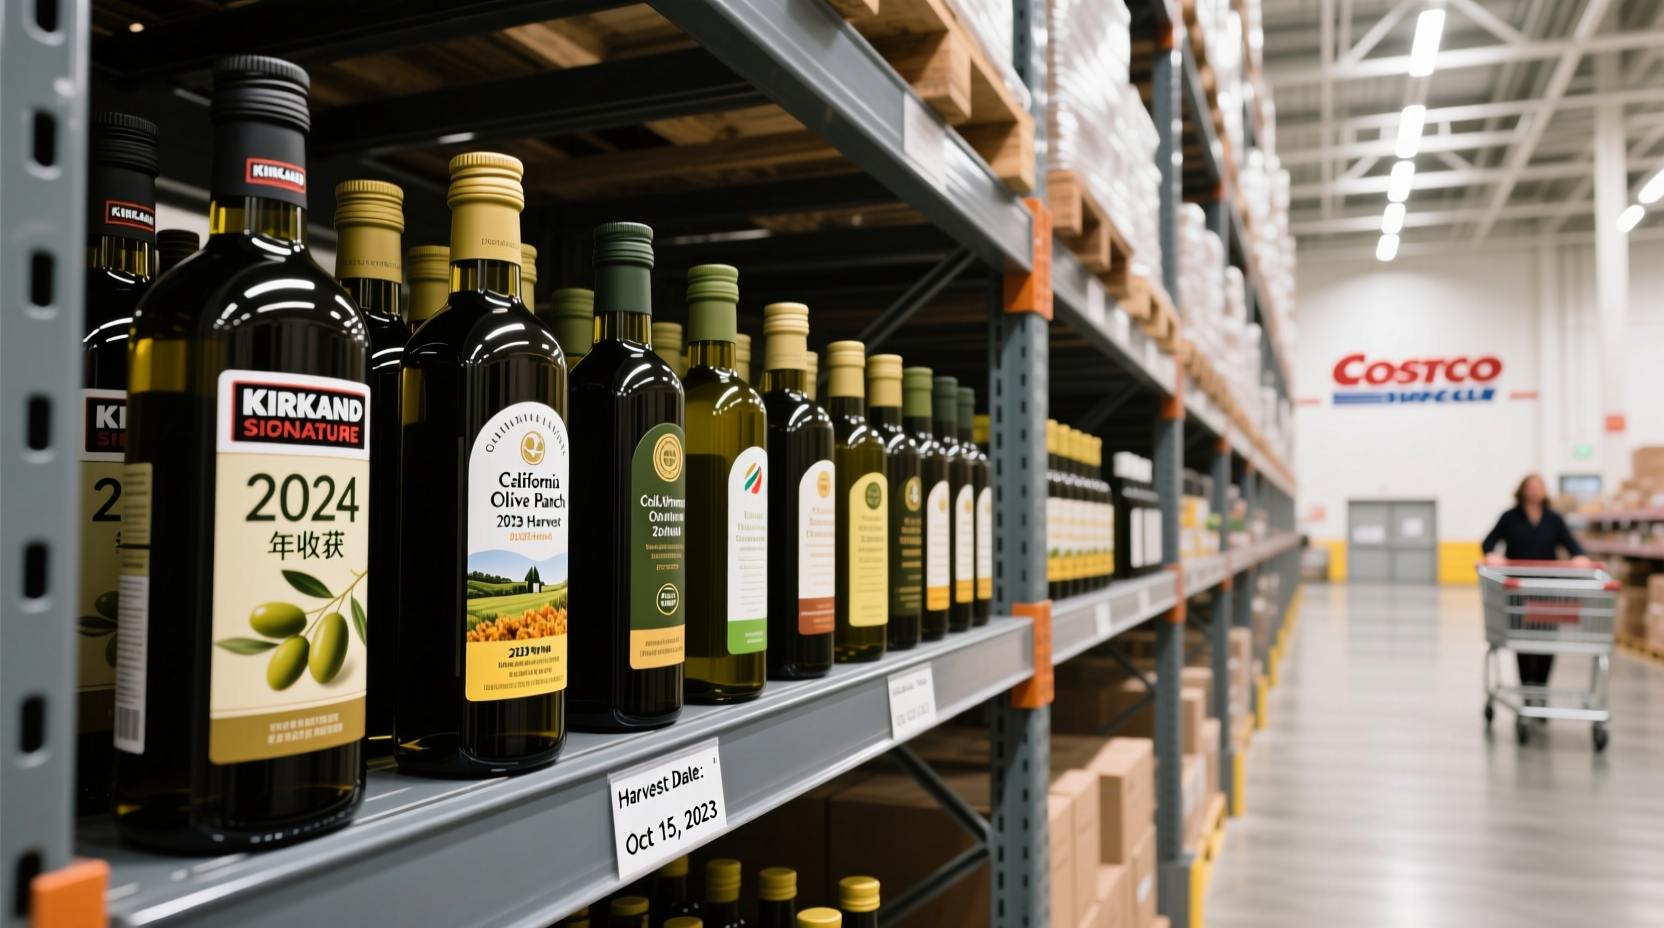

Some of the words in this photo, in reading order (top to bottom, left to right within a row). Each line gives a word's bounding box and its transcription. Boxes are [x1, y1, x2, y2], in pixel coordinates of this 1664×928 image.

[243, 388, 363, 422] KIRKAND
[245, 473, 360, 523] 2024
[490, 491, 530, 508] Olive
[267, 530, 346, 561] 年收获
[618, 776, 670, 809] Harvest
[626, 827, 655, 855] Oct
[658, 815, 682, 841] 15,
[684, 800, 718, 830] 2023
